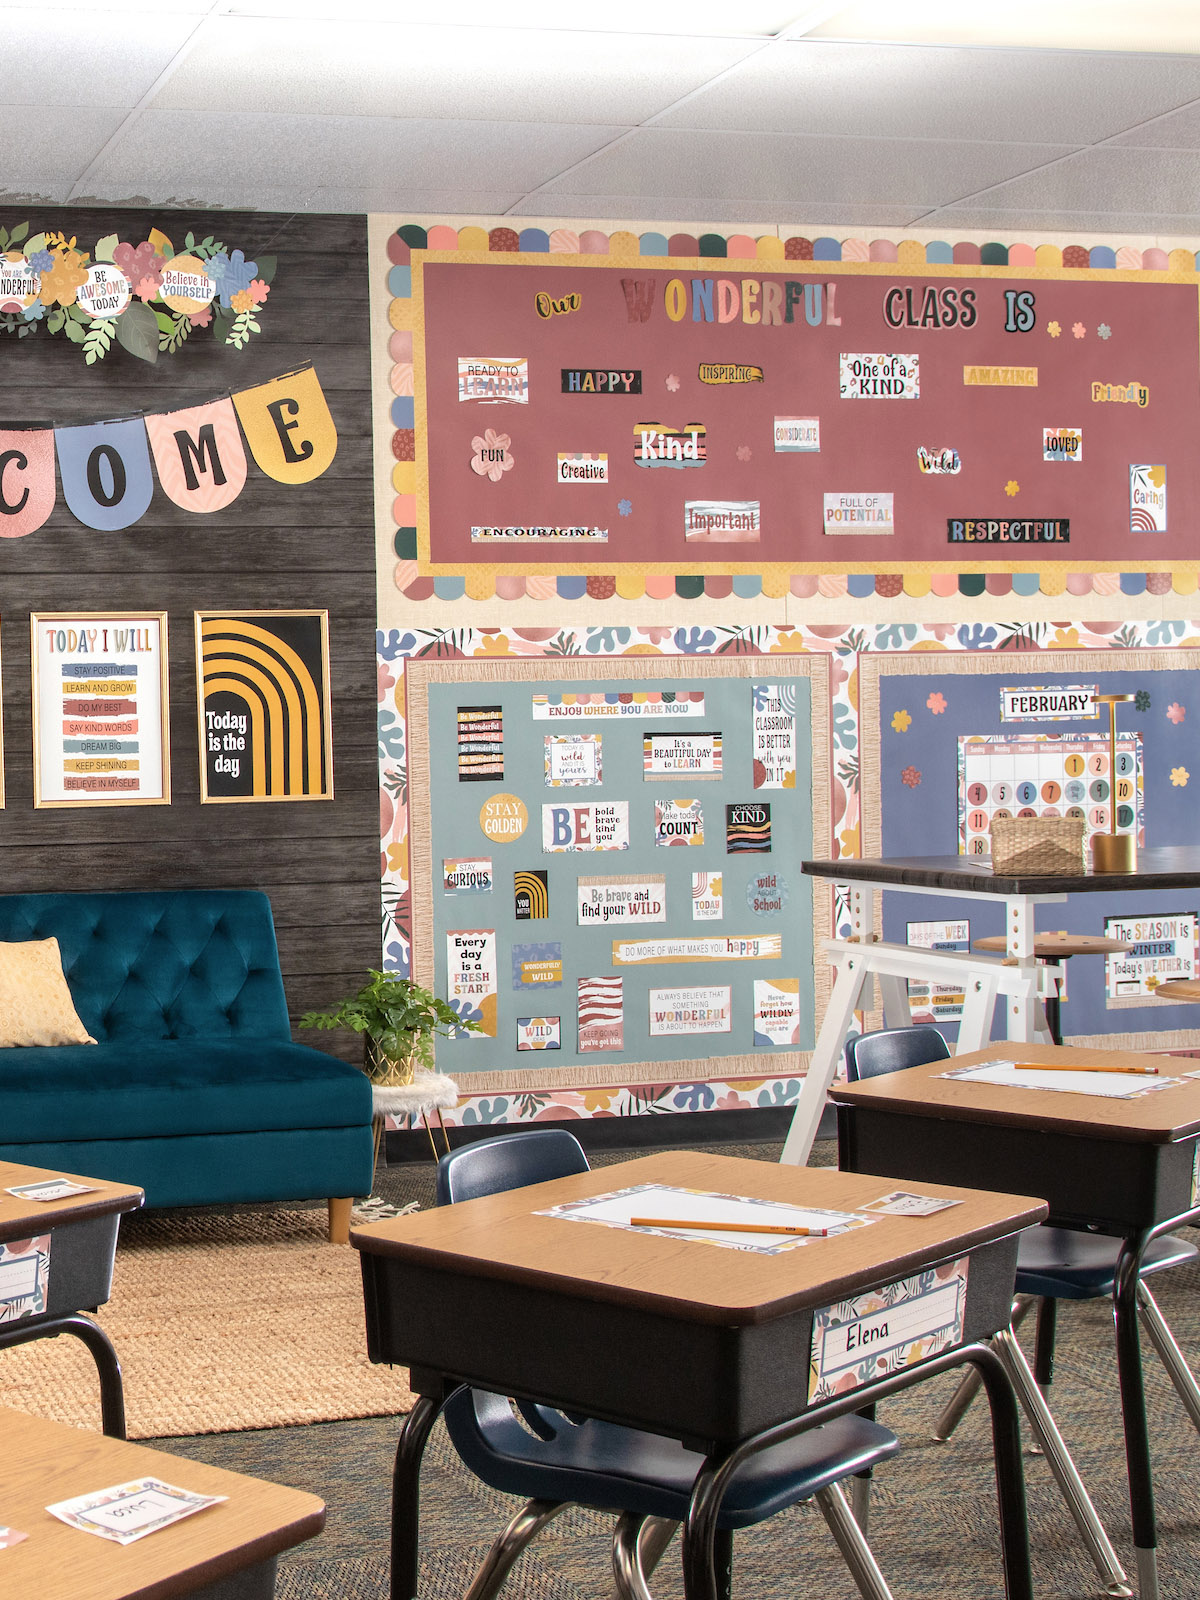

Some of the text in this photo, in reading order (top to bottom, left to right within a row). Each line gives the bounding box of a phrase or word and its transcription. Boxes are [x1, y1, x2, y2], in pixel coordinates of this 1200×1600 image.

[95, 271, 107, 283] BE
[166, 271, 198, 286] Believe
[81, 282, 126, 299] AWESOME
[163, 285, 211, 299] YOURSELF
[91, 297, 119, 311] TODAY
[536, 278, 1035, 332] Our WONDERFUL CLASS IS
[468, 366, 518, 376] READY TO
[702, 367, 750, 380] INSPIRING
[853, 358, 907, 377] One of a
[569, 373, 634, 392] HAPPY
[968, 369, 1034, 384] AMAZING
[463, 377, 523, 396] LEARN
[859, 379, 905, 395] KIND
[1094, 384, 1146, 405] Friendly
[776, 428, 816, 441] CONSIDERATE
[641, 429, 699, 461] Kind
[1047, 437, 1078, 452] LOVED
[481, 449, 504, 462] FUN
[920, 452, 959, 470] Wild
[561, 462, 605, 479] Creative
[840, 498, 878, 507] FULL OF
[1134, 489, 1164, 509] Caring
[689, 509, 755, 534] Important
[827, 509, 891, 521] POTENTIAL
[952, 522, 1063, 540] RESPECTFUL
[47, 628, 152, 653] TODAY I WILL
[75, 665, 125, 675] STAY POSITIVE
[549, 705, 688, 715] ENJOY WHERE YOU ARE NOW
[767, 699, 781, 712] THIS
[1011, 694, 1088, 713] FEBRUARY
[206, 711, 247, 734] Today
[756, 717, 792, 730] CLASSROOM
[208, 733, 246, 750] is the
[758, 735, 790, 748] IS BETTER
[654, 749, 711, 758] BEAUTIFUL DAY
[76, 761, 127, 770] KEEP SHINING
[215, 755, 240, 778] day
[673, 759, 700, 768] LEARN
[1096, 758, 1125, 771] 2 3
[1024, 787, 1028, 799] 6
[1049, 786, 1053, 798] 7
[1119, 784, 1128, 797] 10
[486, 803, 521, 815] STAY
[732, 811, 766, 823] KIND
[975, 811, 1104, 827] 11 16
[485, 818, 522, 833] GOLDEN
[551, 808, 591, 845] BE
[660, 822, 698, 835] COUNT
[596, 834, 612, 843] you
[448, 872, 489, 886] CURIOUS
[757, 876, 777, 888] Wild
[606, 889, 649, 901] brave and
[754, 898, 781, 911] School
[582, 902, 661, 921] find your WILD
[455, 938, 486, 947] Every
[727, 939, 759, 955] happy
[1129, 943, 1171, 955] WINTER
[461, 950, 481, 960] day
[524, 962, 561, 970] WONDERFULLY
[454, 973, 489, 982] FRESH
[454, 985, 489, 994] START
[655, 1009, 726, 1022] WONDERFUL
[525, 1026, 552, 1036] WILD
[847, 1322, 889, 1352] Elena
